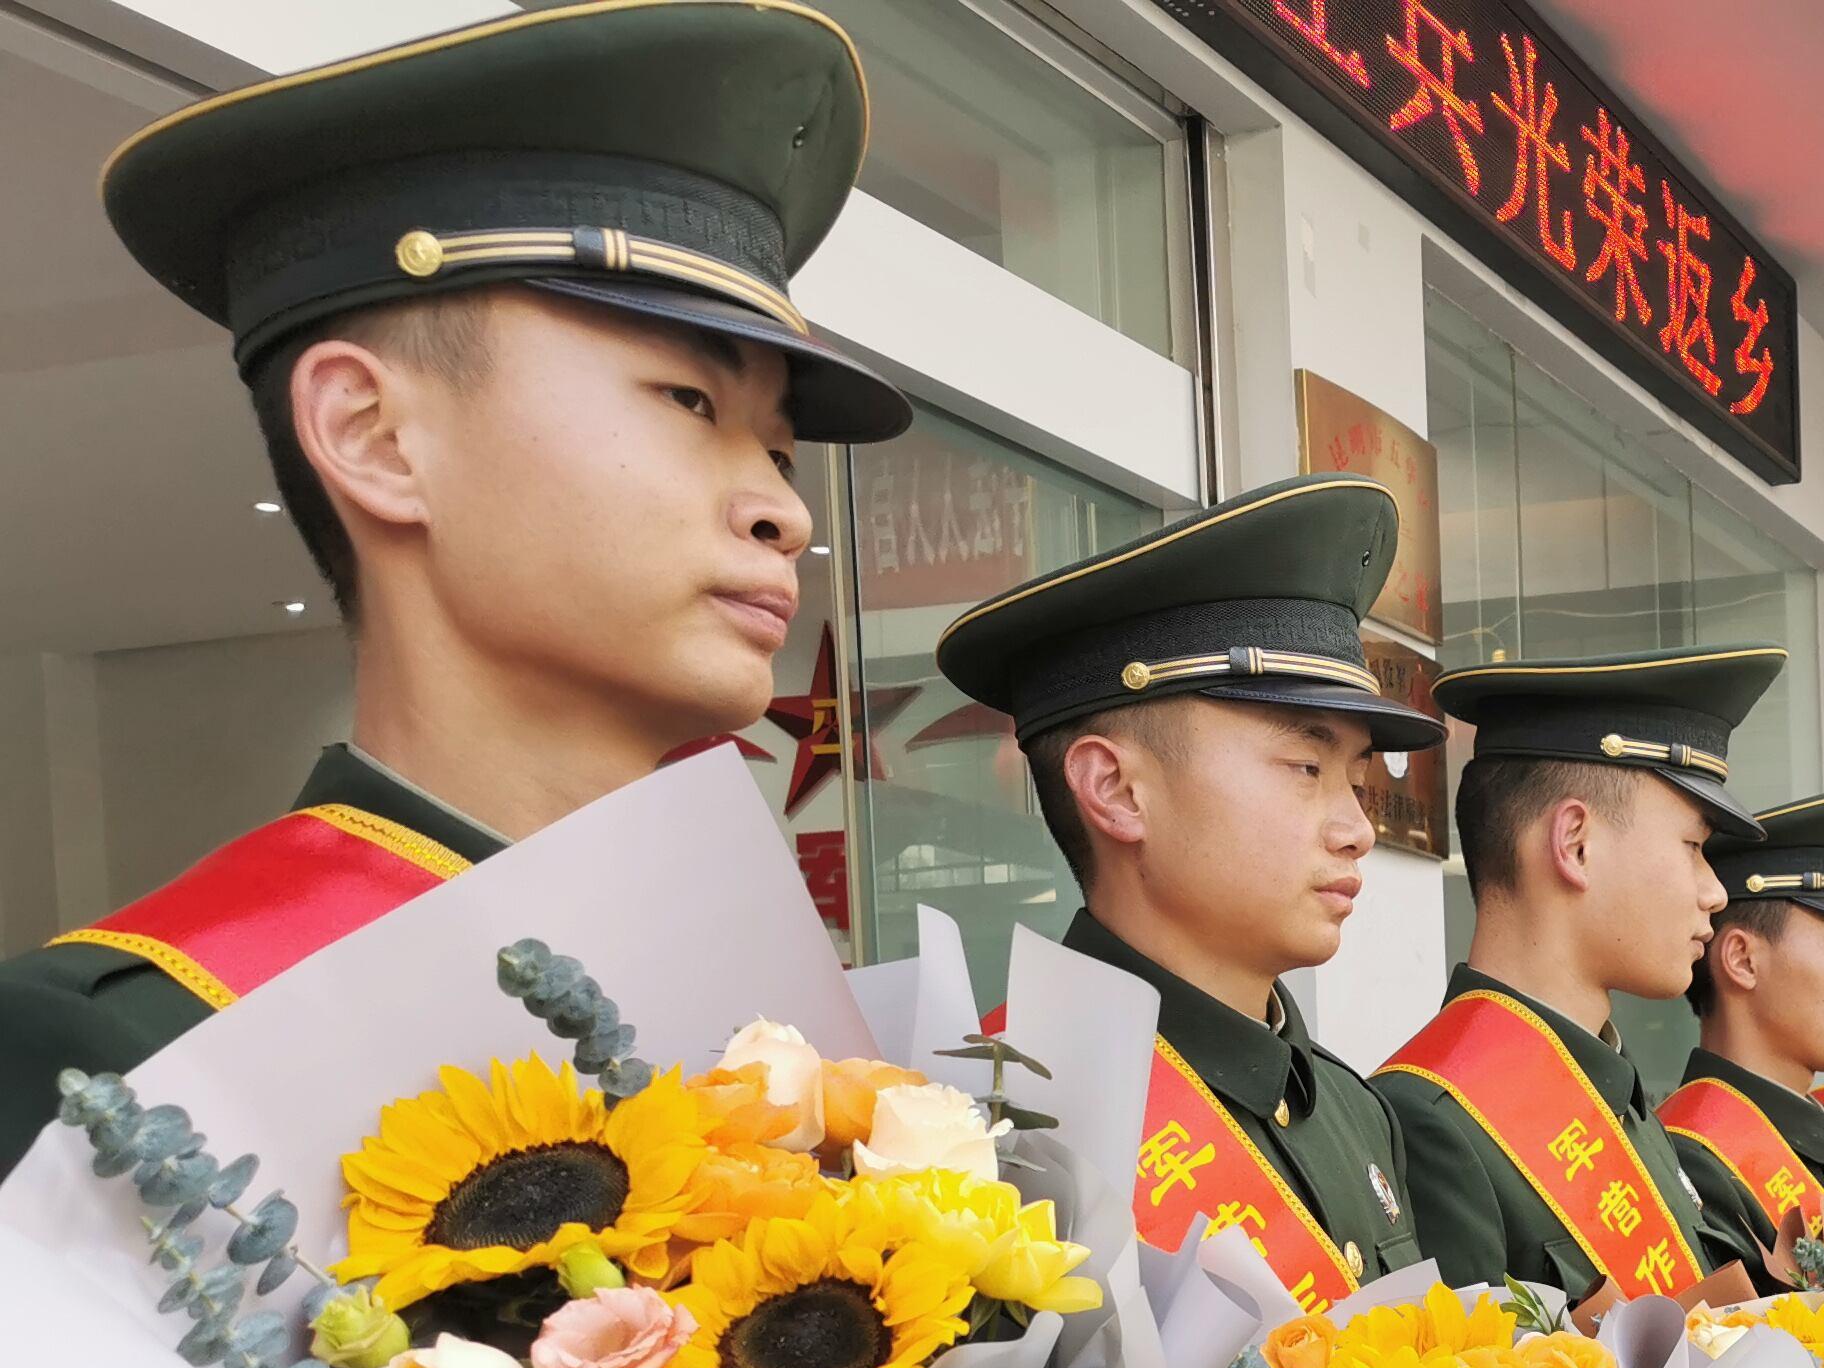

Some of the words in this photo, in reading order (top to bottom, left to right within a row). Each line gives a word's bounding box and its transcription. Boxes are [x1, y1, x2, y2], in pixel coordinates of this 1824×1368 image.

[1271, 0, 1774, 415] 兵光荣返乡
